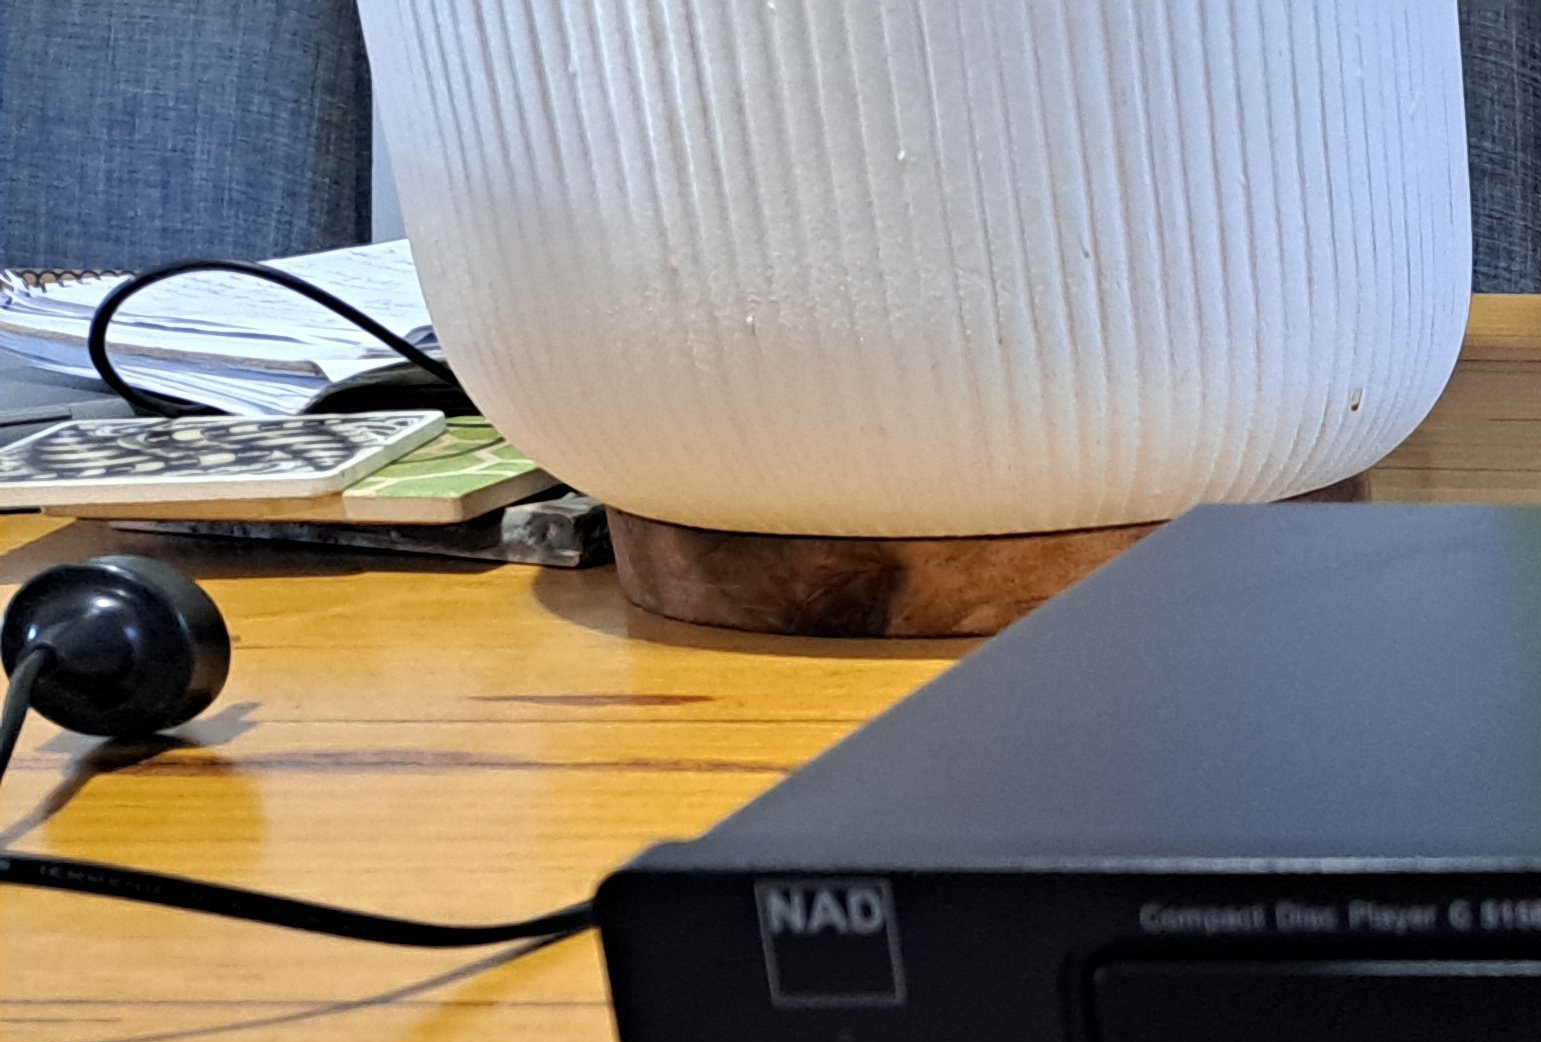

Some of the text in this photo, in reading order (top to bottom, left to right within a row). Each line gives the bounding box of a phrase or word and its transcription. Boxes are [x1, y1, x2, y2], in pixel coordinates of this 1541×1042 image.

[767, 887, 883, 935] NAD
[1139, 900, 1265, 935] Compact
[1275, 899, 1338, 932] Disc
[1348, 899, 1436, 935] Player
